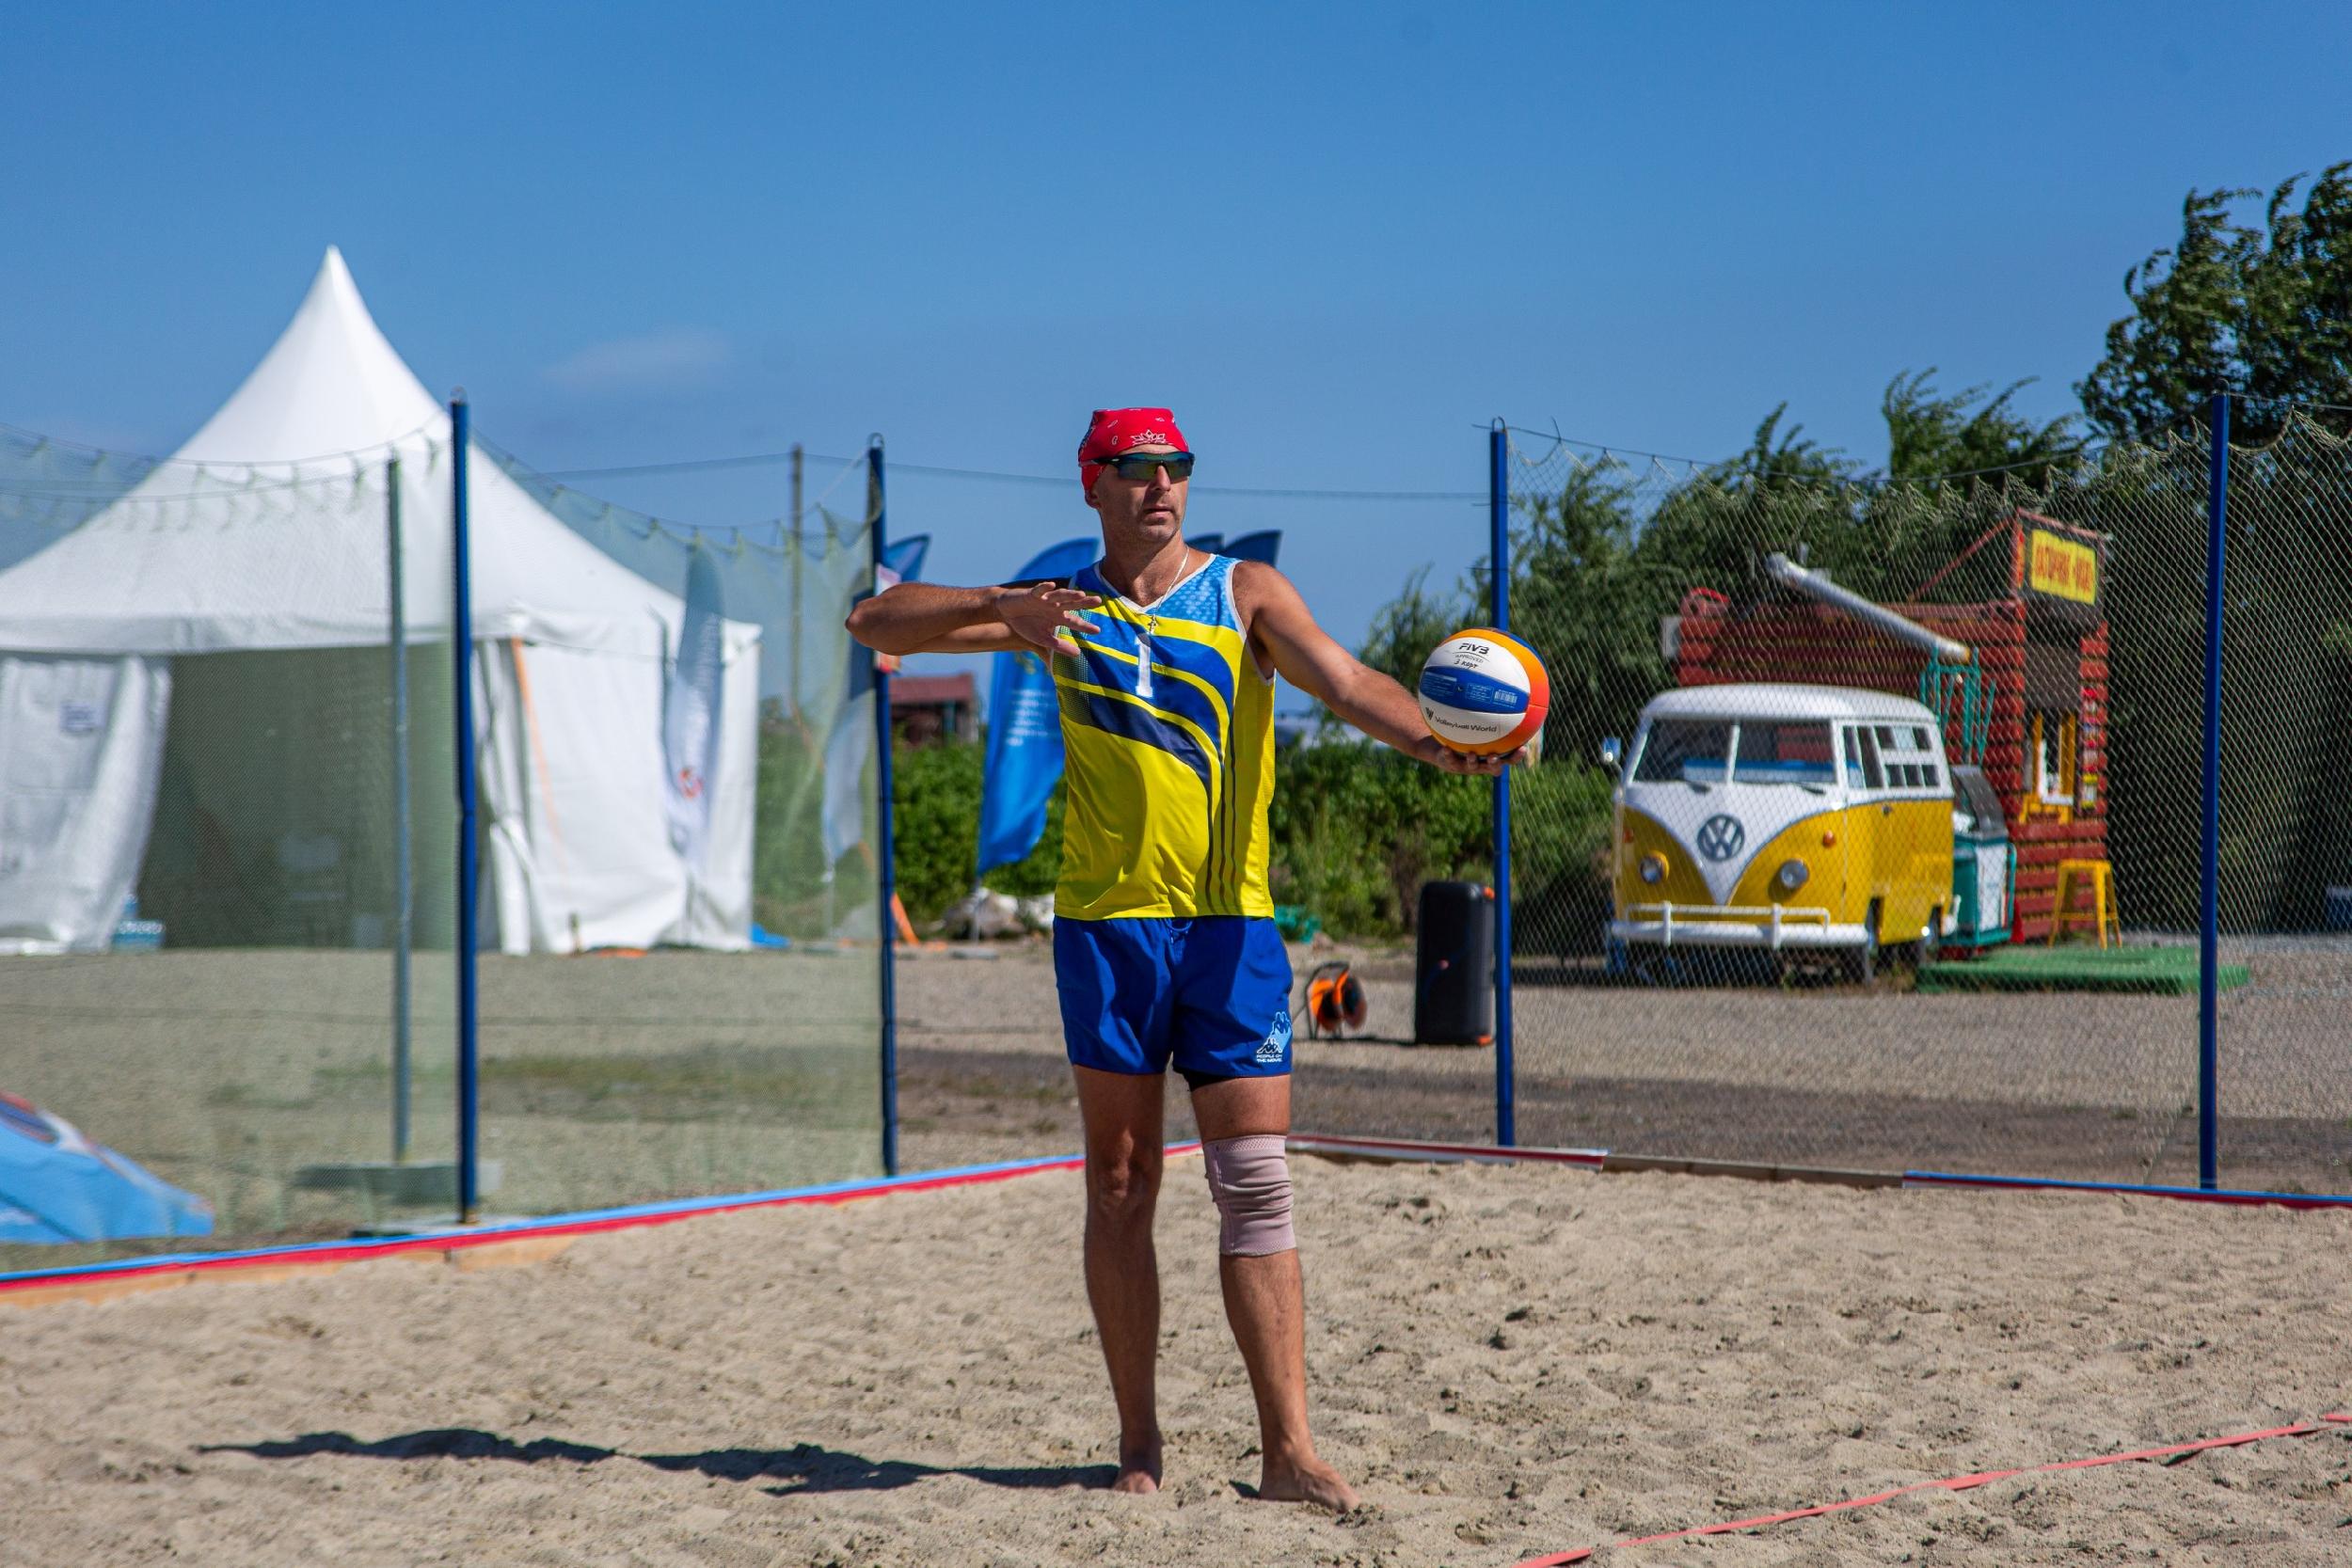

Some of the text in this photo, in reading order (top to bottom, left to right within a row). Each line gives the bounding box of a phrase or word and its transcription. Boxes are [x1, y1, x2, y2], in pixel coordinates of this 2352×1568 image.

[1459, 643, 1489, 654] FIVB
[1135, 633, 1153, 698] 1
[1455, 655, 1484, 663] APPROVED
[1435, 716, 1498, 733] Volleyball World
